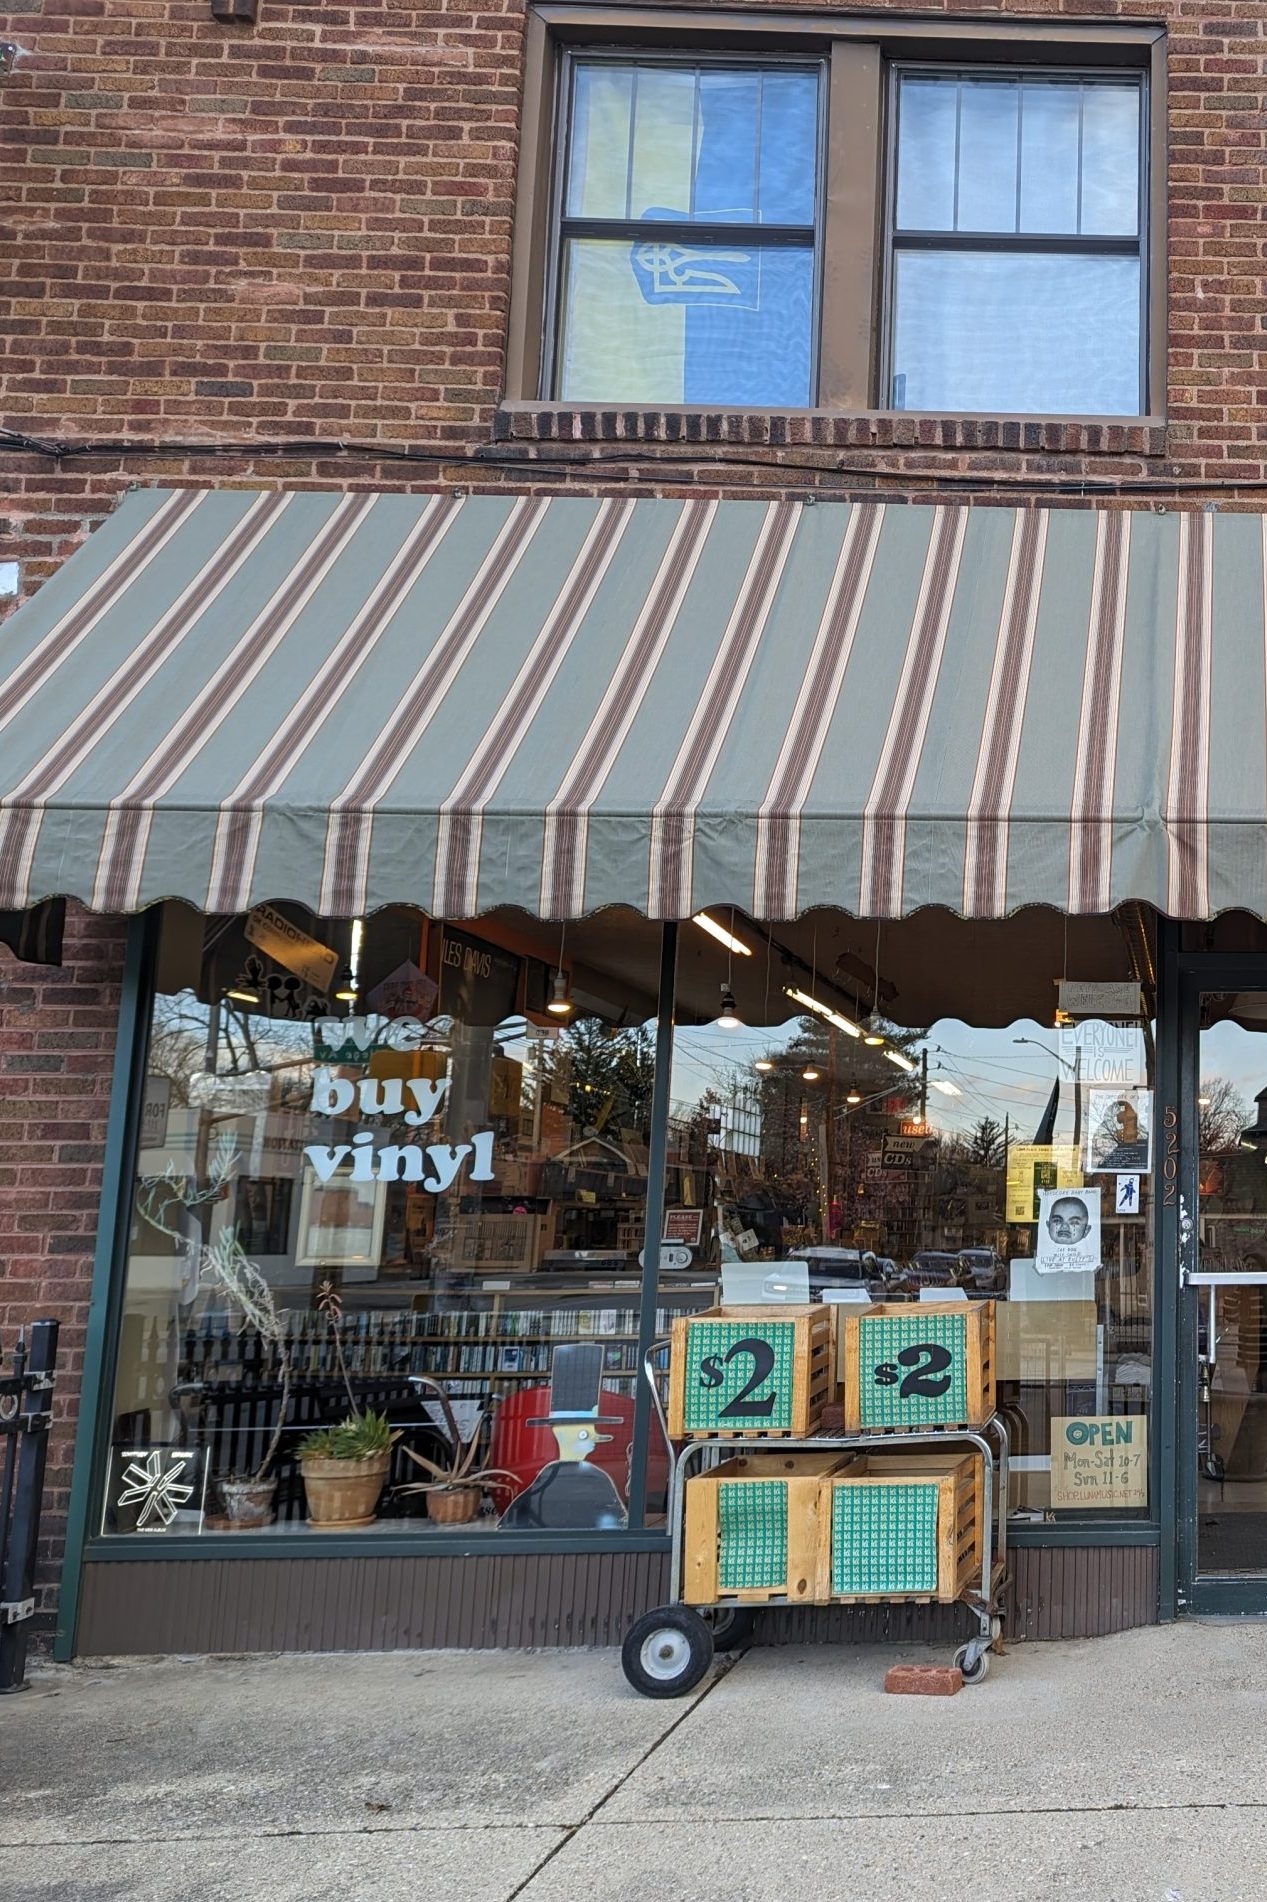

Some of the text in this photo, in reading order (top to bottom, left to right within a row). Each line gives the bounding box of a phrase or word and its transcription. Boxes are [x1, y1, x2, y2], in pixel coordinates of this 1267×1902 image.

[463, 946, 492, 978] DAVIS
[313, 1015, 425, 1052] we
[1093, 1047, 1105, 1058] IS
[1060, 1058, 1134, 1081] WELCOME
[310, 1066, 452, 1126] buy
[884, 1152, 912, 1165] CDs
[893, 1141, 914, 1149] new
[1163, 1106, 1180, 1206] 5202
[303, 1131, 495, 1193] vinyl
[699, 1337, 778, 1418] $2
[874, 1343, 953, 1399] $2
[1066, 1420, 1133, 1446] OPEN
[1063, 1448, 1141, 1470] Mon-Sat 10-7
[1073, 1471, 1098, 1487] Sun
